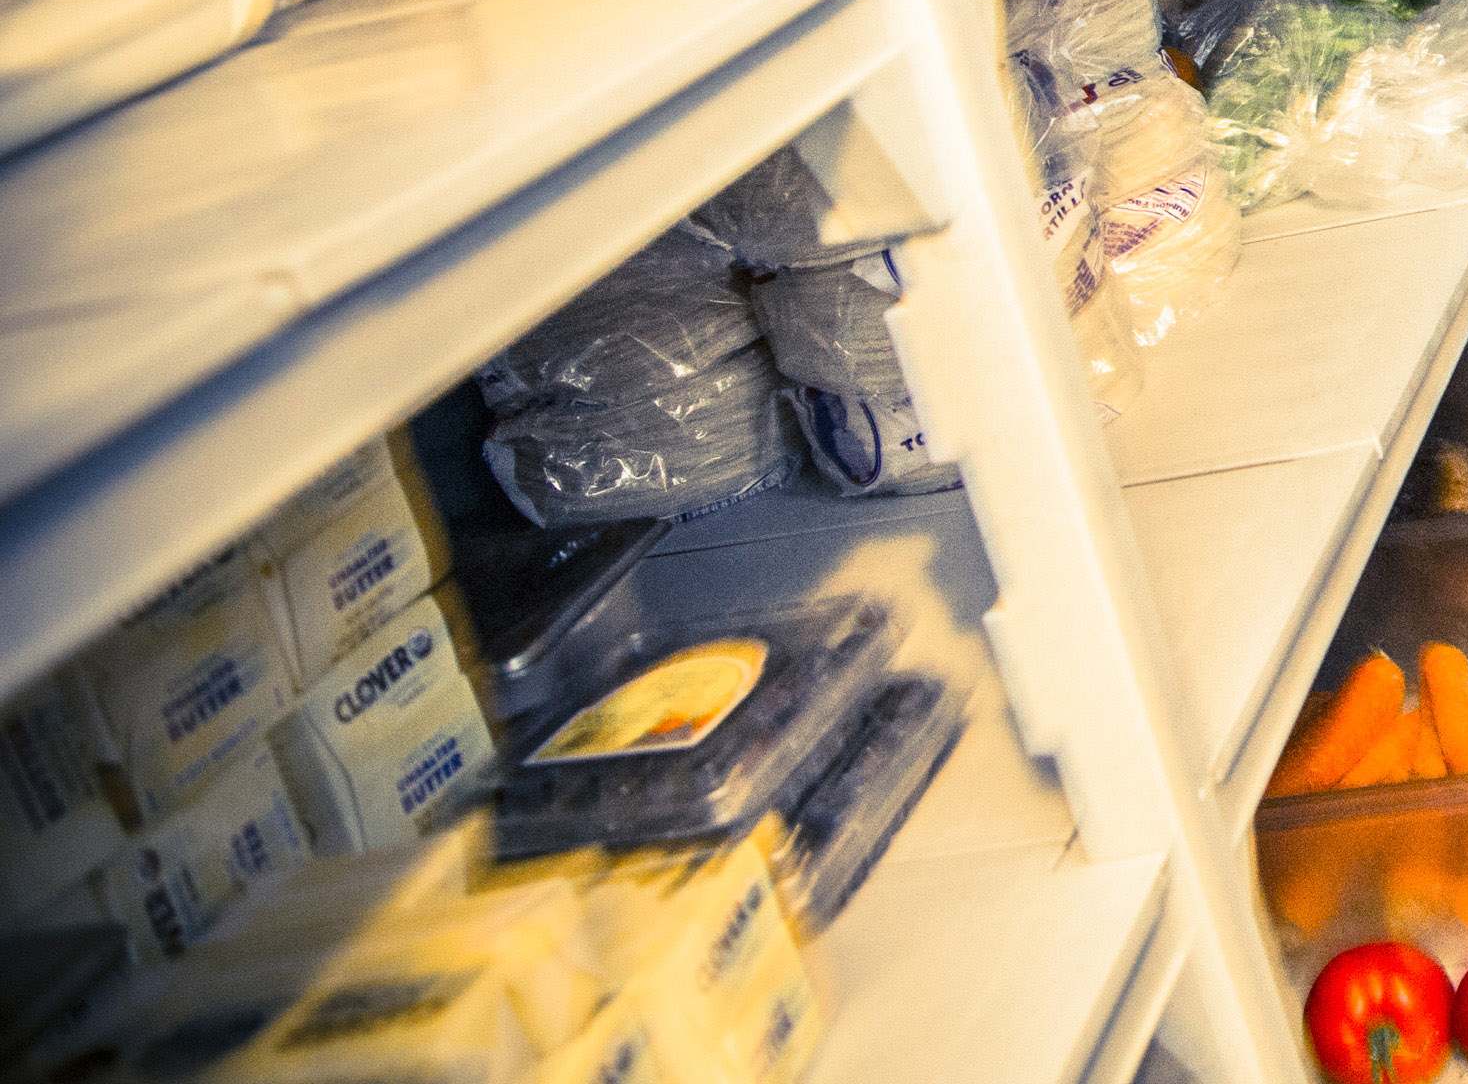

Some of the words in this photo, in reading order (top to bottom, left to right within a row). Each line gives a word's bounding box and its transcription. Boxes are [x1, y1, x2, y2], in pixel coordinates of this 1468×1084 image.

[1041, 183, 1074, 217] ORN
[1127, 197, 1149, 210] Fac
[334, 643, 416, 725] CLOVER
[401, 752, 464, 816] BUTTER
